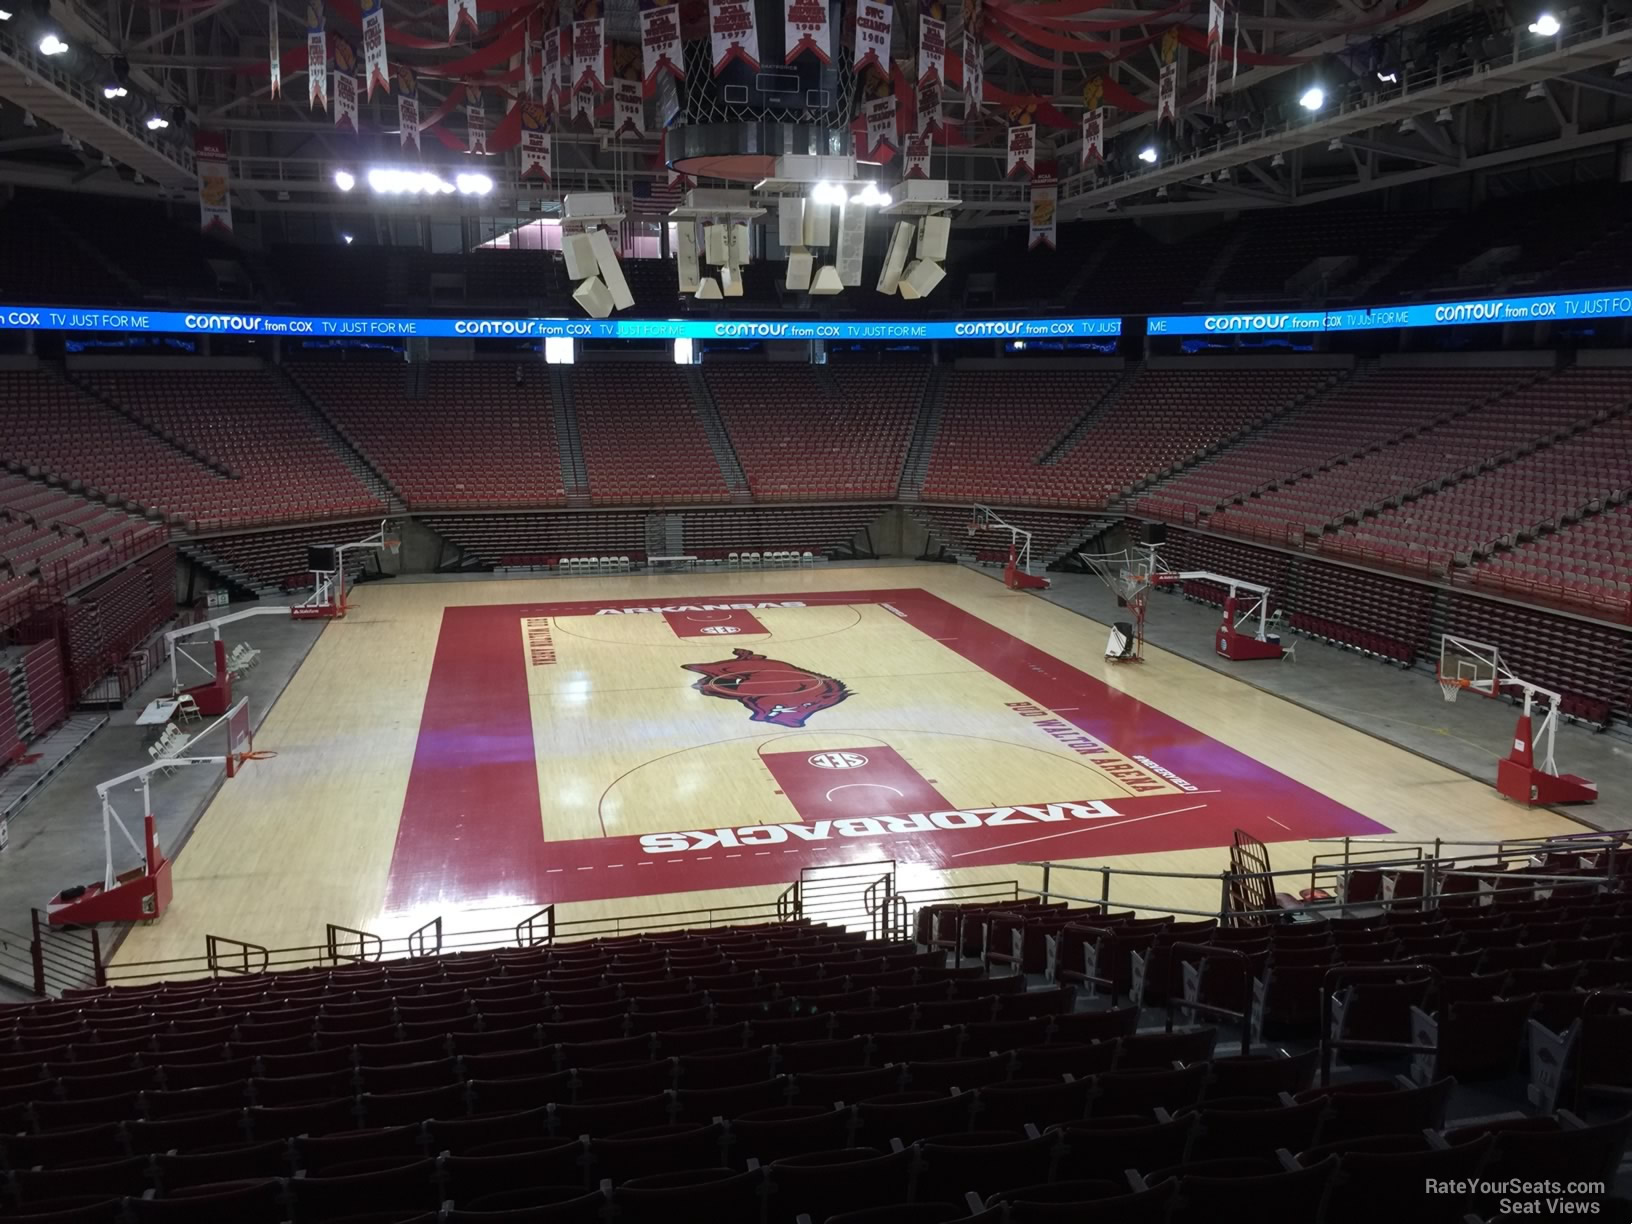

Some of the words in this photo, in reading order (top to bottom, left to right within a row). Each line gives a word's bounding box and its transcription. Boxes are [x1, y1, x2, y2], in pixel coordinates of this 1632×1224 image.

[865, 6, 884, 19] SWC
[722, 31, 746, 40] 1977
[1504, 304, 1528, 318] from
[1530, 302, 1556, 316] COX
[1564, 301, 1579, 314] TV
[1581, 299, 1610, 313] JUST
[8, 312, 40, 325] COX
[50, 314, 66, 326] TV
[69, 314, 100, 326] JUST
[102, 315, 128, 327] FOR
[131, 316, 149, 328] ME
[1292, 318, 1319, 328] from
[1323, 316, 1341, 326] COX
[1347, 315, 1357, 325] TV
[1357, 314, 1377, 325] JUST
[1377, 312, 1394, 323] FOR
[1396, 311, 1408, 322] ME
[264, 321, 287, 332] from
[289, 322, 313, 332] COX
[322, 322, 337, 332] TV
[339, 322, 368, 332] JUST
[371, 322, 396, 333] FOR
[398, 323, 416, 333] ME
[538, 325, 563, 335] from
[566, 325, 592, 335] COX
[600, 325, 614, 334] TV
[616, 325, 642, 335] JUST
[644, 325, 667, 335] FOR
[669, 325, 685, 335] ME
[791, 326, 814, 336] from
[816, 326, 840, 336] COX
[848, 326, 860, 336] TV
[862, 326, 886, 336] JUST
[888, 326, 909, 336] FOR
[911, 326, 926, 336] ME
[1026, 325, 1048, 334] from
[1050, 323, 1074, 333] COX
[1082, 322, 1096, 332] TV
[1097, 322, 1122, 332] JUST
[1150, 321, 1166, 331] ME
[596, 602, 807, 615] ARKANSAS
[1004, 702, 1048, 717] BUD
[1033, 719, 1108, 754] WALTON
[1090, 757, 1168, 792] ARENA
[812, 753, 866, 768] SEC
[640, 801, 1125, 854] RAZORBACKS
